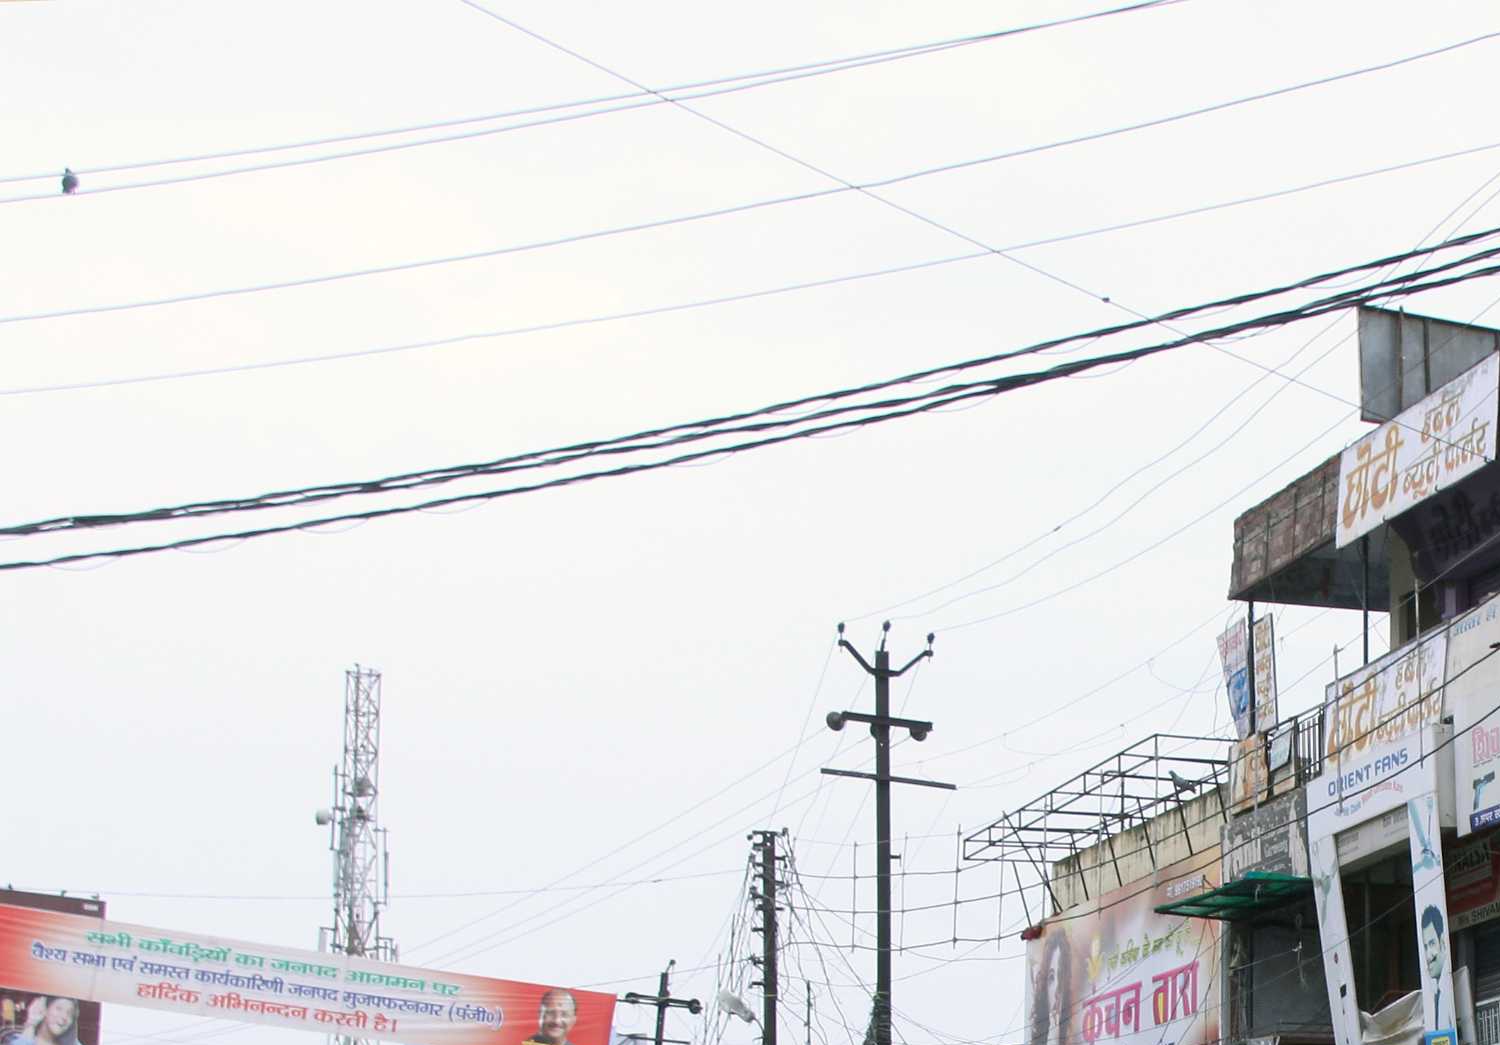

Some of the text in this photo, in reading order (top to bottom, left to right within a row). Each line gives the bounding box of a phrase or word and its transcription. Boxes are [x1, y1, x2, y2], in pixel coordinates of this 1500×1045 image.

[1374, 748, 1408, 776] FANS
[72, 952, 106, 969] सभा
[111, 954, 138, 973] एवं
[140, 961, 190, 980] समस्त
[288, 981, 338, 1001] जनपद
[86, 930, 132, 949] सभी
[235, 950, 264, 969] का
[271, 957, 337, 980] जनपद
[345, 968, 425, 992] आगमन
[431, 982, 461, 997] पर
[137, 981, 201, 1004] हार्दिक
[313, 1006, 367, 1030] करती
